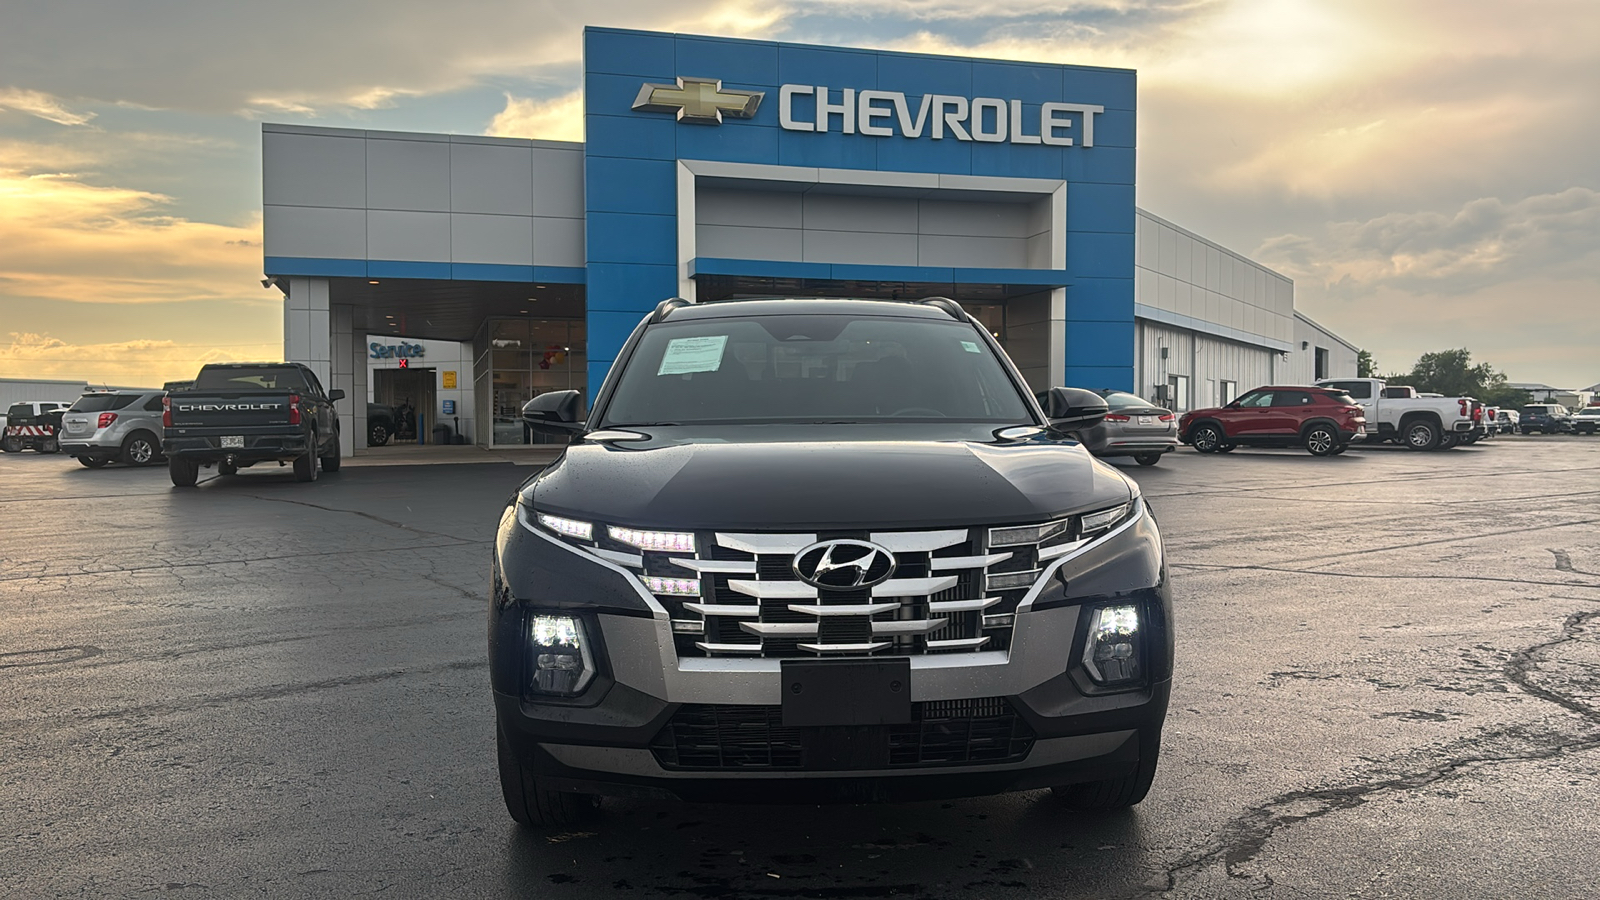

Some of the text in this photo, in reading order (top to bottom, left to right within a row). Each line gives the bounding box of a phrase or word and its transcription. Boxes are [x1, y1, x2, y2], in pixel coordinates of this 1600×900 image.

[779, 84, 1105, 147] CHEVROLET
[369, 341, 424, 359] Service
[180, 404, 281, 412] CHEVROLET
